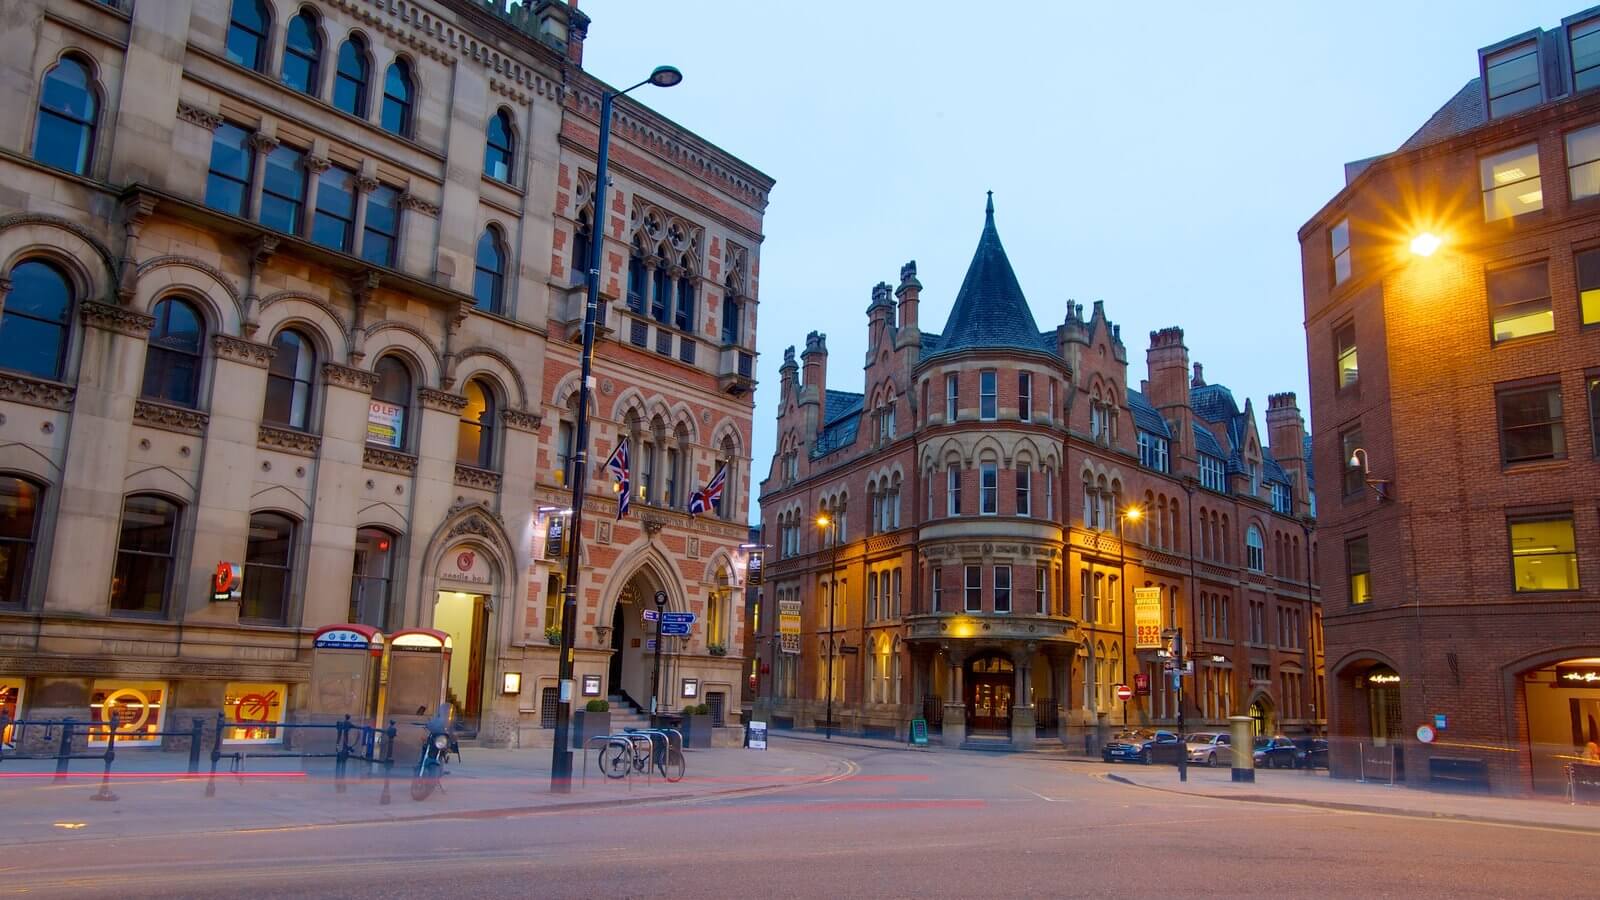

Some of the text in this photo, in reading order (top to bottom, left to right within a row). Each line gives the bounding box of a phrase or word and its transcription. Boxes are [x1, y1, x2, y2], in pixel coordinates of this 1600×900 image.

[368, 402, 400, 417] TO LET
[1138, 626, 1159, 635] 832
[782, 633, 800, 642] 832
